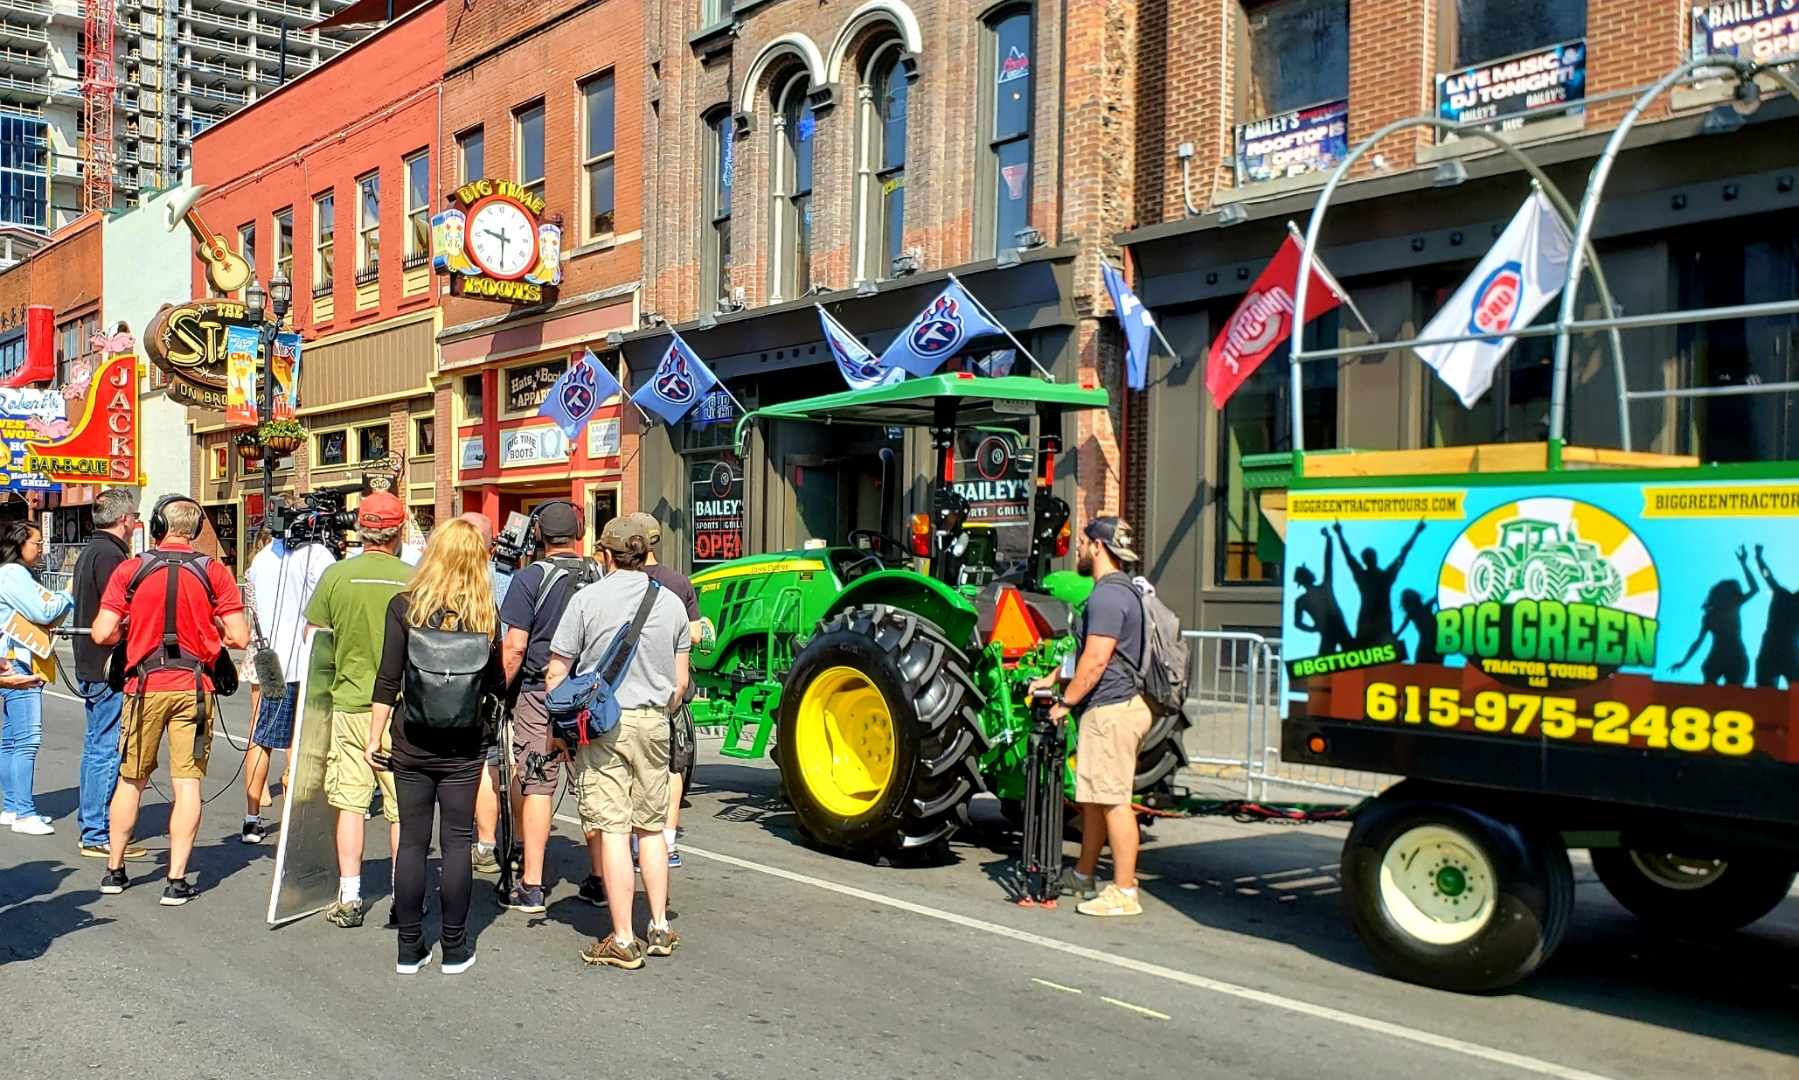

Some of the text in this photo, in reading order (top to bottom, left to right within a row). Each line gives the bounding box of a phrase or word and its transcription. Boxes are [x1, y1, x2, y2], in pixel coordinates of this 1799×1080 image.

[1709, 0, 1794, 28] BAILEYS
[1446, 70, 1492, 95] LIVE
[1492, 52, 1560, 83] MUSIC
[1450, 90, 1478, 110] DJ
[1245, 111, 1301, 140] BAILEY'S
[1246, 121, 1346, 157] ROOFTOP IS
[457, 178, 546, 216] BIG TIME
[463, 276, 541, 302] BOOTS
[216, 302, 245, 320] THE
[230, 351, 253, 363] CMA
[511, 367, 562, 394] Hats Boot
[180, 384, 198, 400] ON
[709, 394, 730, 407] BUD
[106, 365, 135, 481] JACKS
[704, 405, 733, 420] LIGHT
[508, 434, 537, 452] BIG TIME
[509, 447, 534, 460] BOOTS
[29, 456, 108, 475] BAR-B-QUE
[1292, 497, 1458, 514] BIGGREENTRACTORTOURS.COM
[696, 520, 719, 531] SPORTS
[767, 563, 790, 572] DEERE
[1435, 598, 1659, 667] BIG GREEN
[1293, 644, 1396, 678] #BGTTOURS
[1481, 658, 1599, 681] TRACTOR TOURS
[1364, 682, 1755, 756] 615-975-2488
